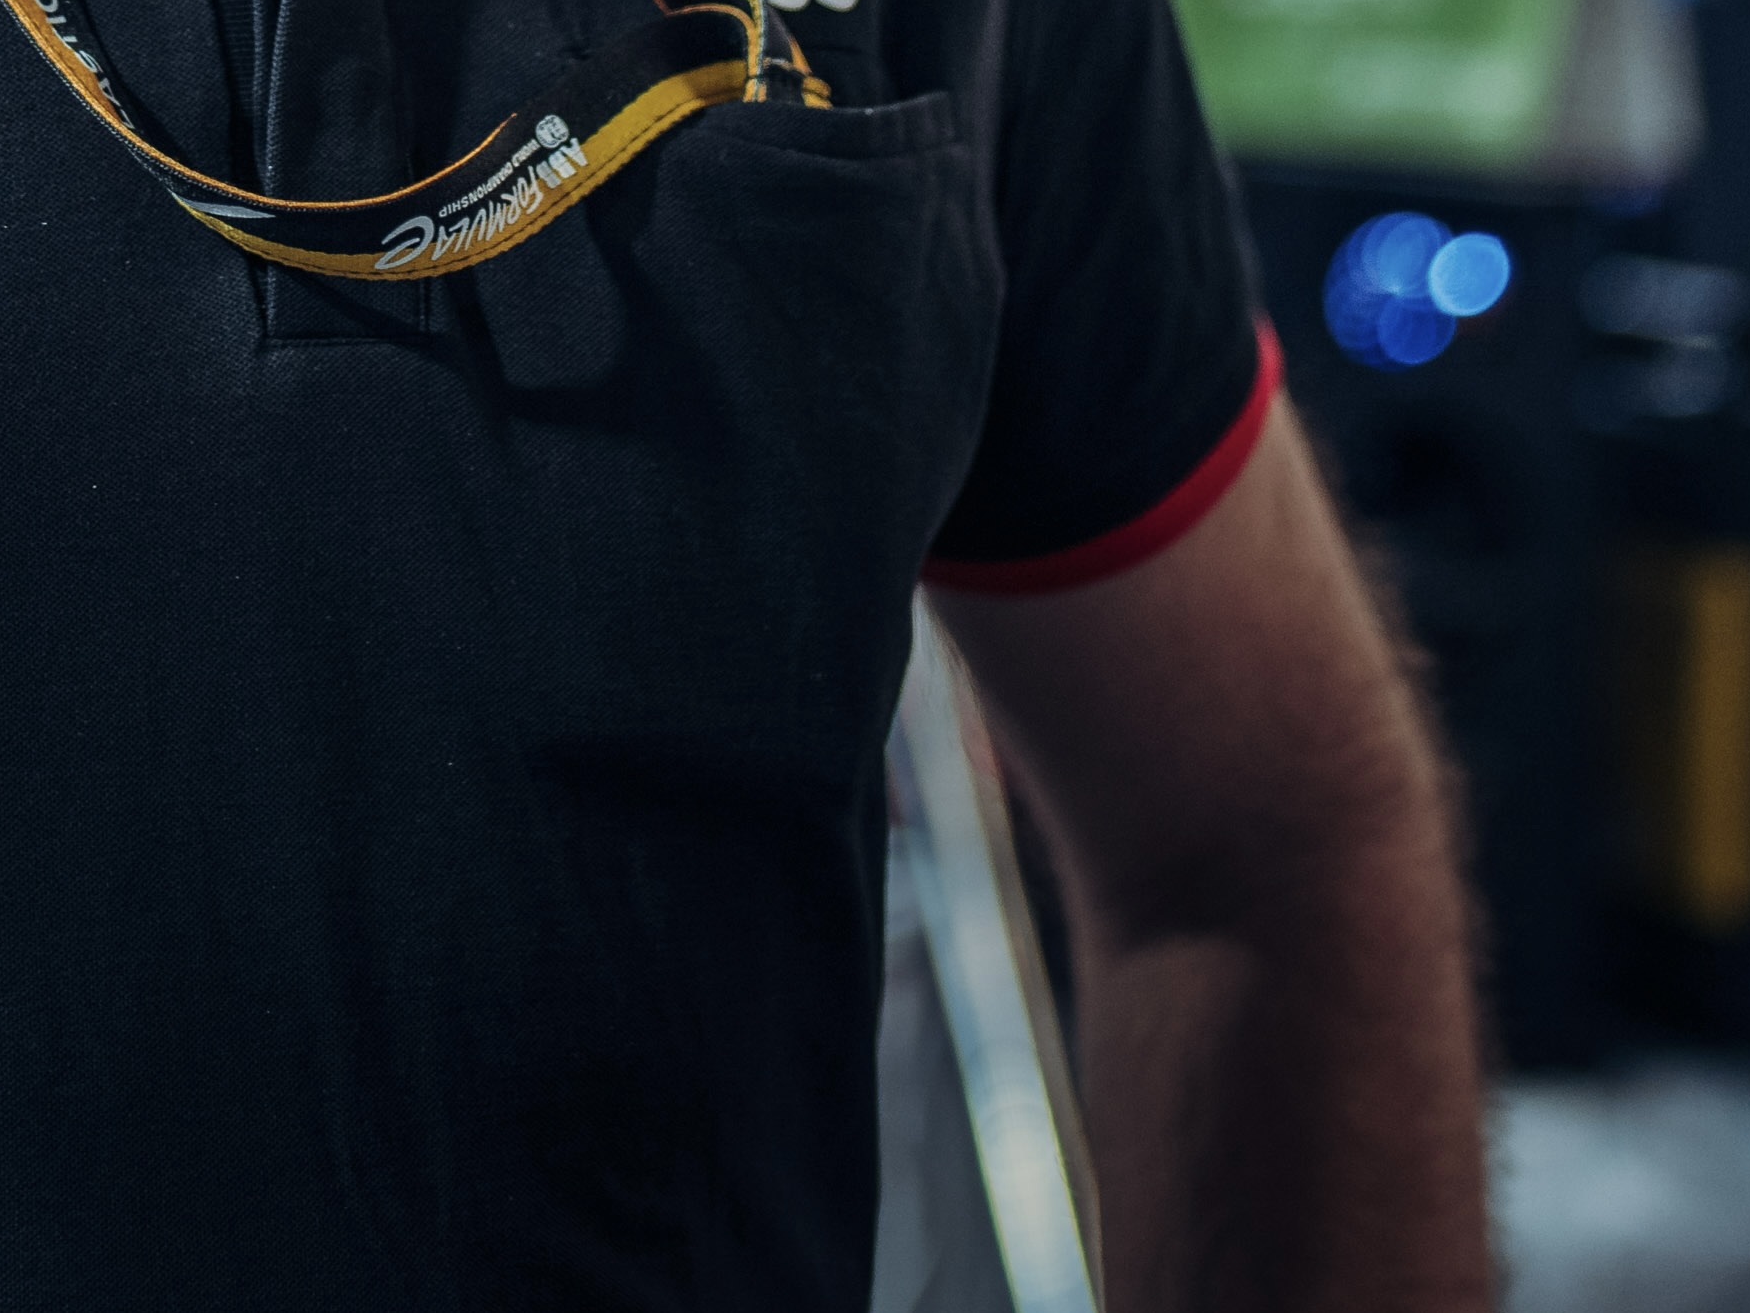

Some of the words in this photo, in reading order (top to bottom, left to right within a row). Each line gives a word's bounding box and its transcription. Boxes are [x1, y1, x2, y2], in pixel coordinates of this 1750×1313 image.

[512, 138, 542, 168] WORLD
[536, 137, 589, 189] ABB
[438, 162, 514, 218] CHAMPIONSHIP
